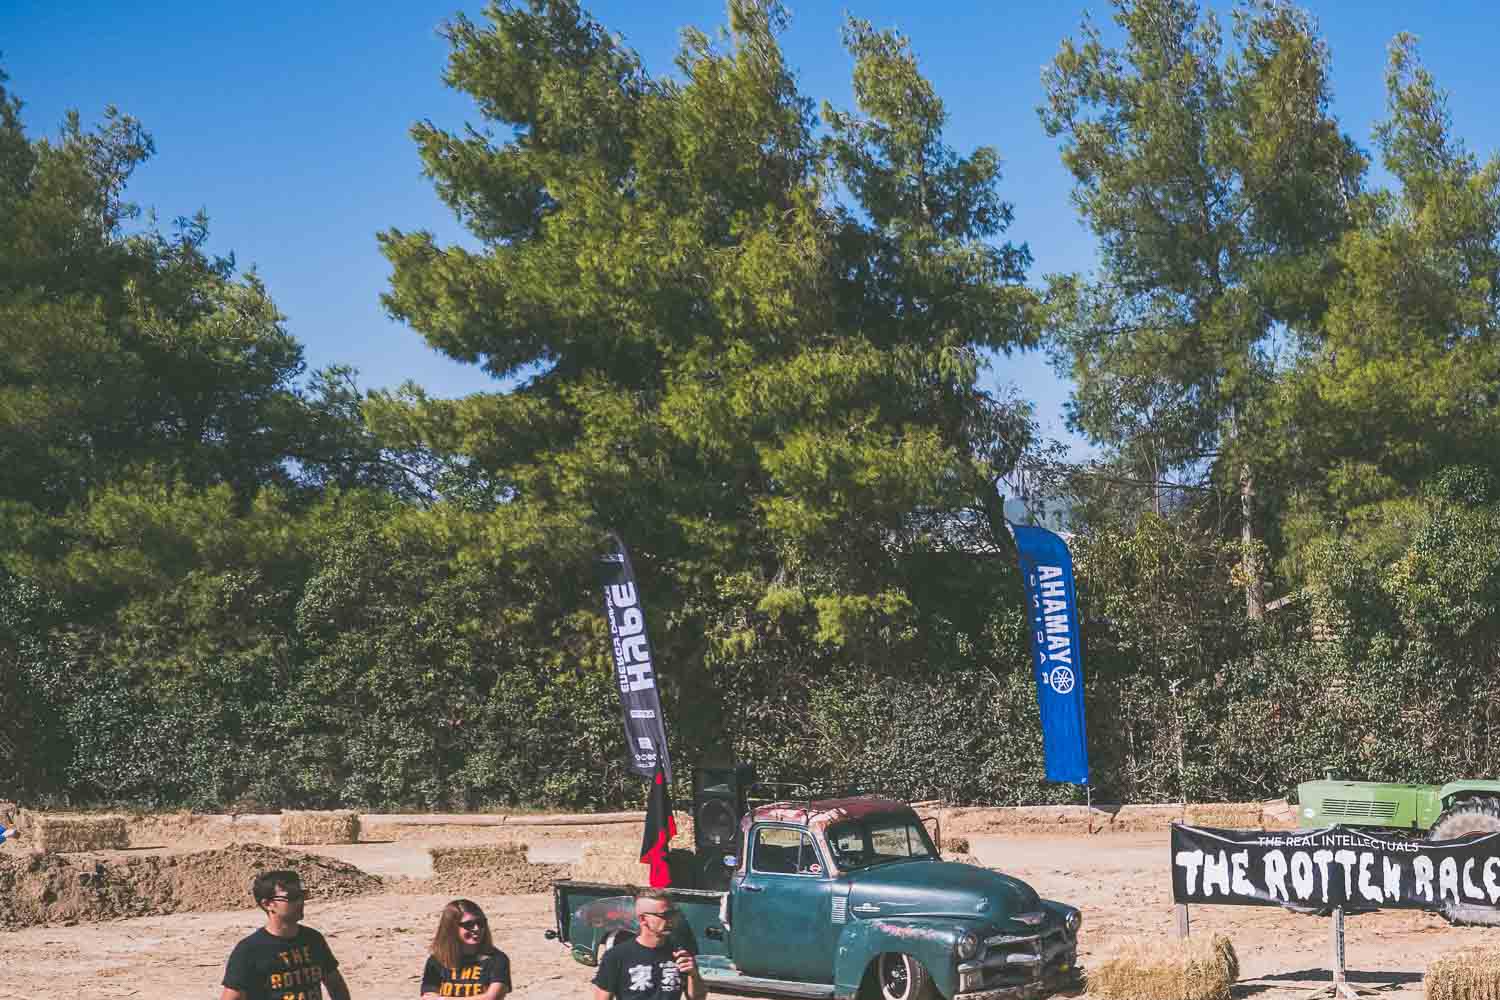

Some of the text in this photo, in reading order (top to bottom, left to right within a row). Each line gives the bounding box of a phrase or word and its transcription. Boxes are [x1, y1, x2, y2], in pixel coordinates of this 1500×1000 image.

[1258, 834, 1420, 853] THE REAL INTELLECTUALS
[1175, 850, 1256, 897] THE
[1263, 849, 1401, 903] ROTTEN
